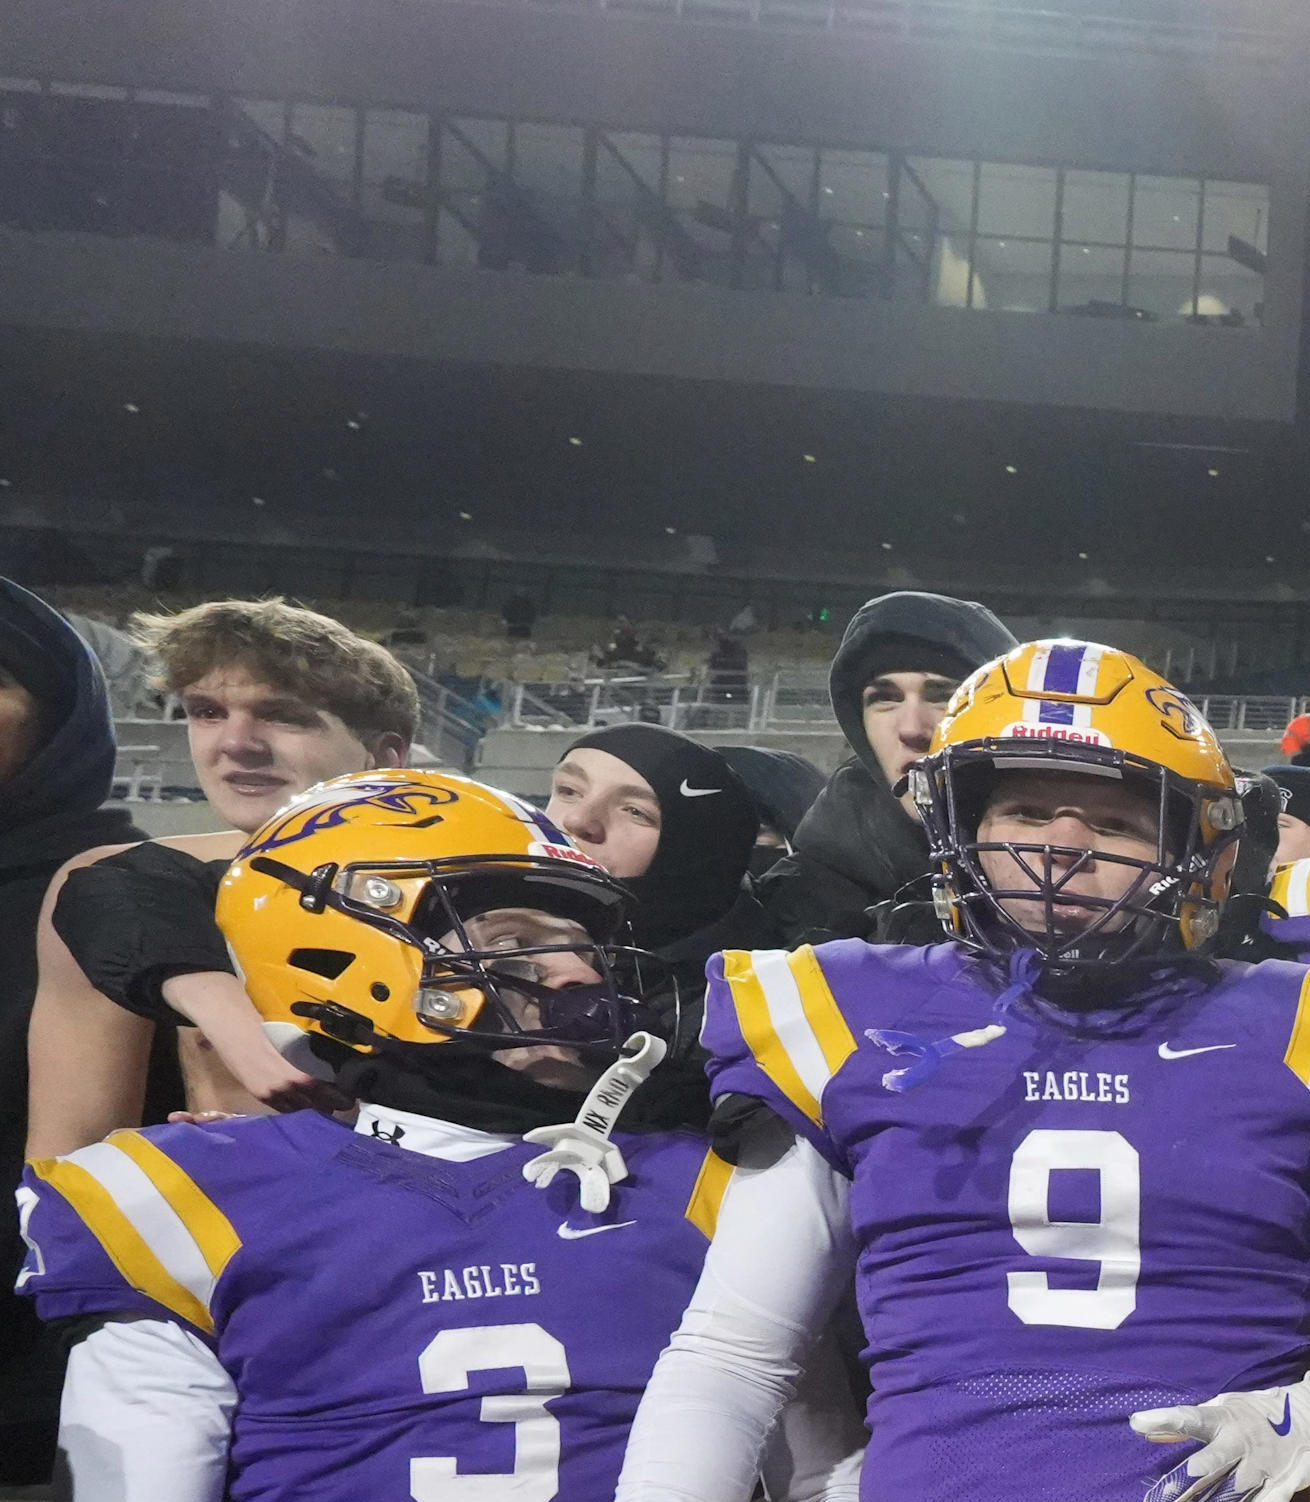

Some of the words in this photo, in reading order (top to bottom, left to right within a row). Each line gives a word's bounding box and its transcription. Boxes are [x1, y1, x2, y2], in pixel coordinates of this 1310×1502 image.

[1023, 1071, 1130, 1104] EAGLES
[1007, 1129, 1141, 1330] 9
[417, 1262, 541, 1304] EAGLES
